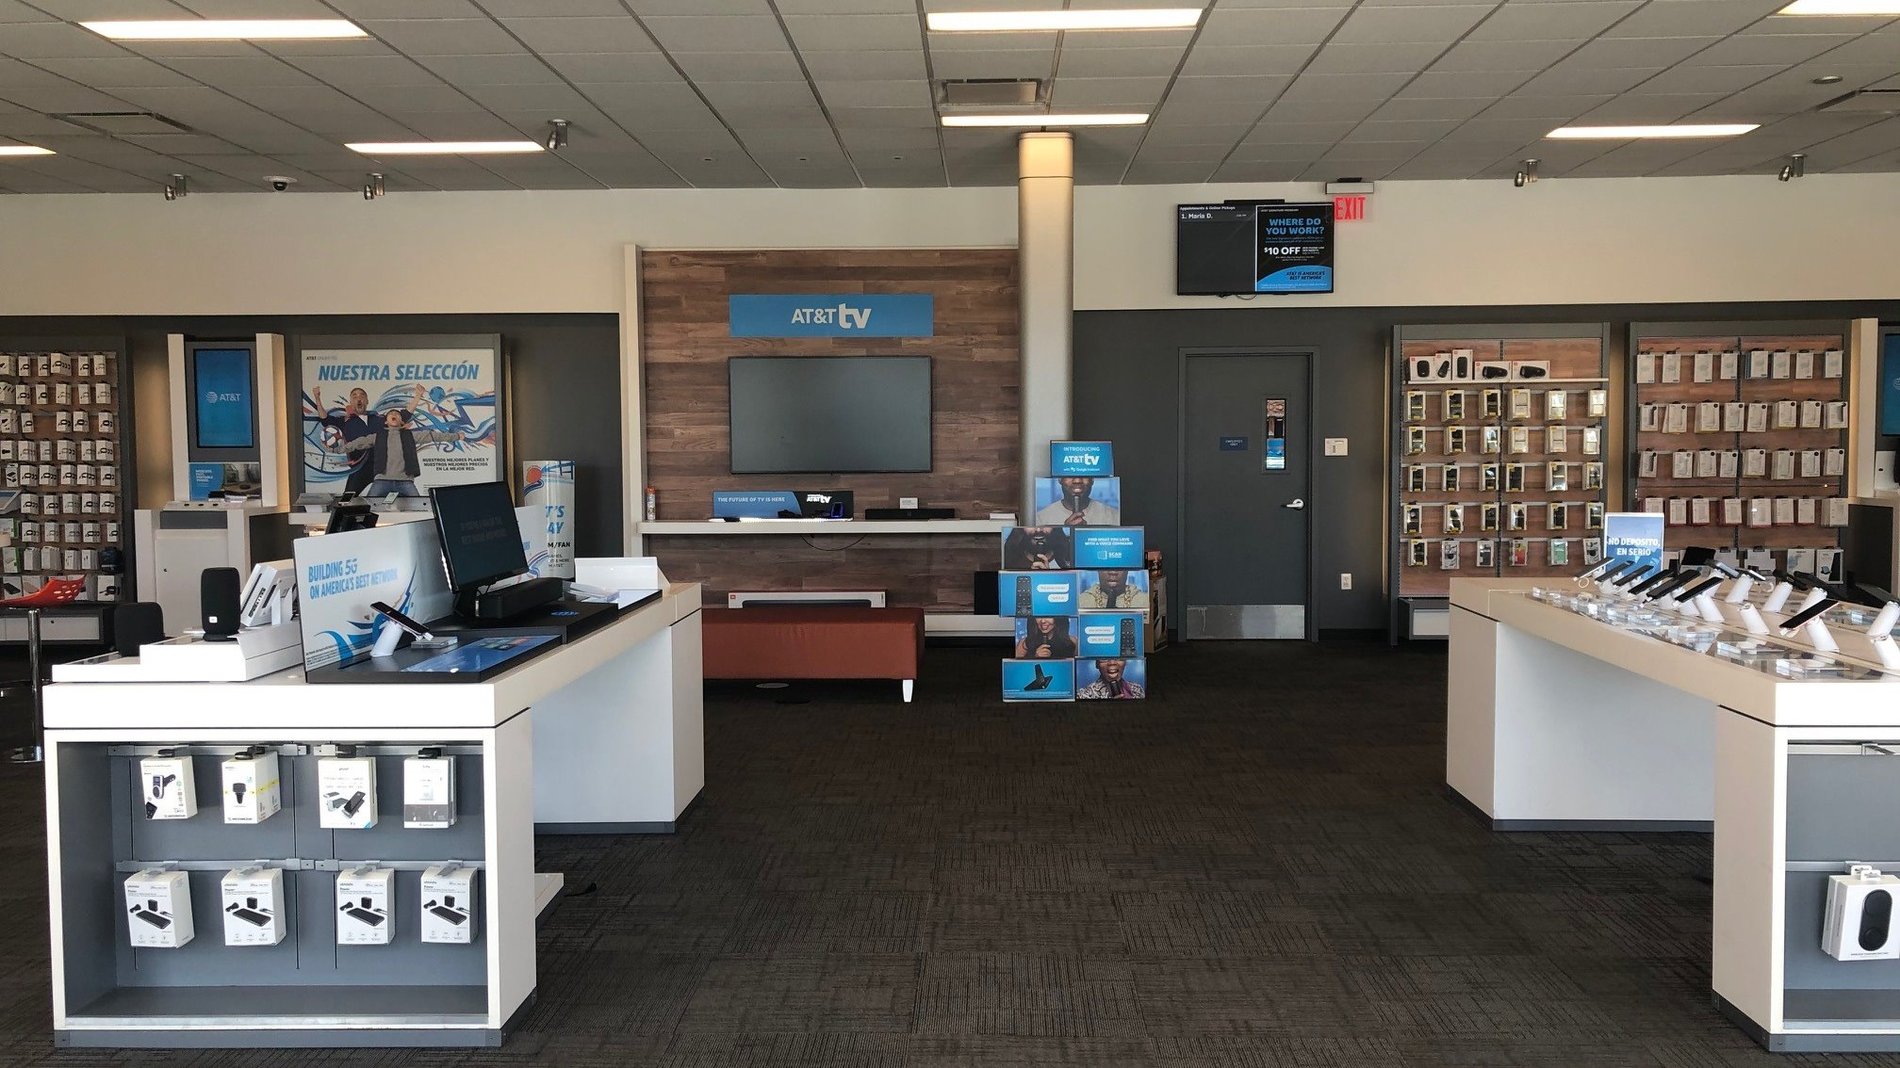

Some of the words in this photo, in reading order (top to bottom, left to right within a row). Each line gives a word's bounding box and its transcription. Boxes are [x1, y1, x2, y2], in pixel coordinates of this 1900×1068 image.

[1335, 197, 1366, 220] EXIT
[1269, 218, 1304, 226] WHERE
[1306, 217, 1321, 226] DO
[1266, 227, 1287, 235] YOU
[1289, 226, 1325, 235] WORK?
[1264, 246, 1280, 255] $10
[1280, 246, 1301, 255] OFF
[791, 308, 837, 325] AT&T
[838, 302, 872, 330] tv
[318, 364, 391, 381] NUESTRA
[395, 360, 480, 381] SELECCIÓN
[219, 392, 242, 402] AT&T
[1063, 455, 1084, 464] AT&T
[1084, 453, 1100, 466] tv
[545, 505, 565, 518] T'S
[547, 522, 565, 534] AY
[547, 541, 571, 549] M/FAN
[1608, 537, 1620, 546] NO
[1616, 547, 1628, 556] EN
[1628, 547, 1651, 556] SERIO
[308, 560, 343, 583] BUILDING
[345, 558, 358, 575] 5G
[310, 585, 320, 600] ON
[320, 576, 355, 598] AMERICA'S
[355, 573, 370, 590] BEST
[370, 567, 398, 586] NETWORK
